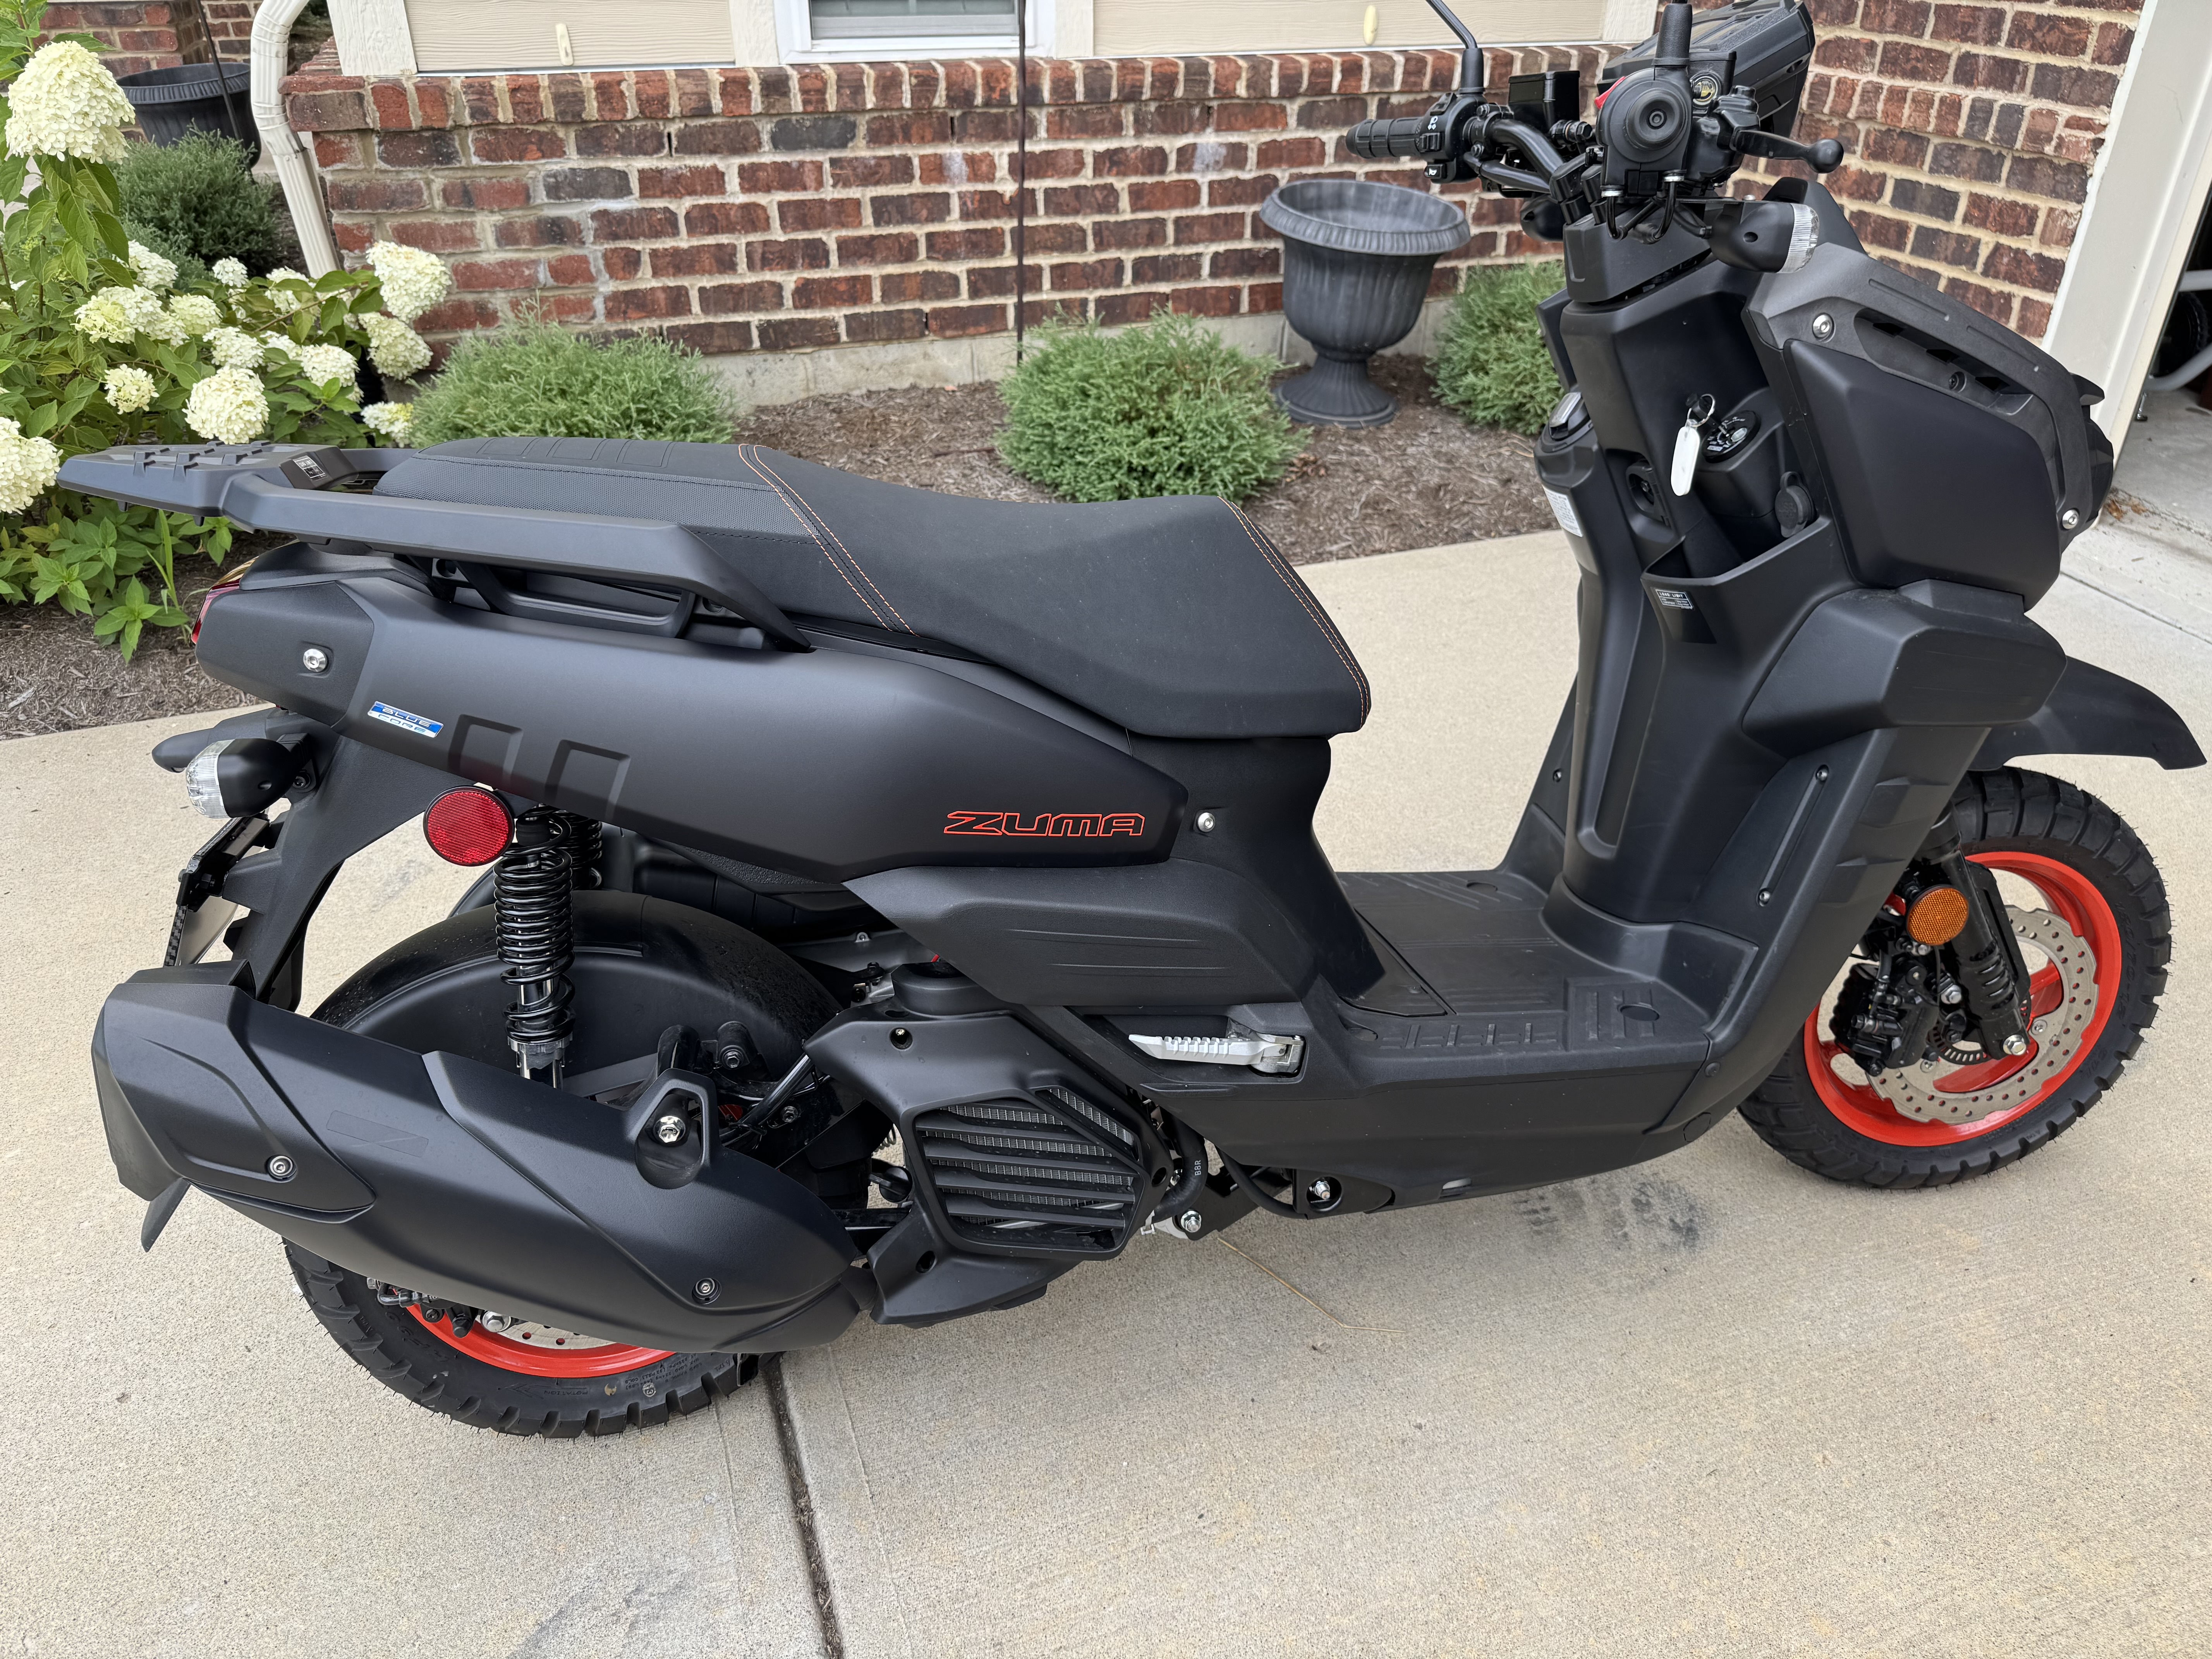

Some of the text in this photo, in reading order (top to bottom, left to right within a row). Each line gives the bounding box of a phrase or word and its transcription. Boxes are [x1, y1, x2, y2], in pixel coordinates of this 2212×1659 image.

[378, 714, 426, 733] CORE
[382, 707, 431, 727] BLUE
[943, 811, 1146, 836] ZUMA
